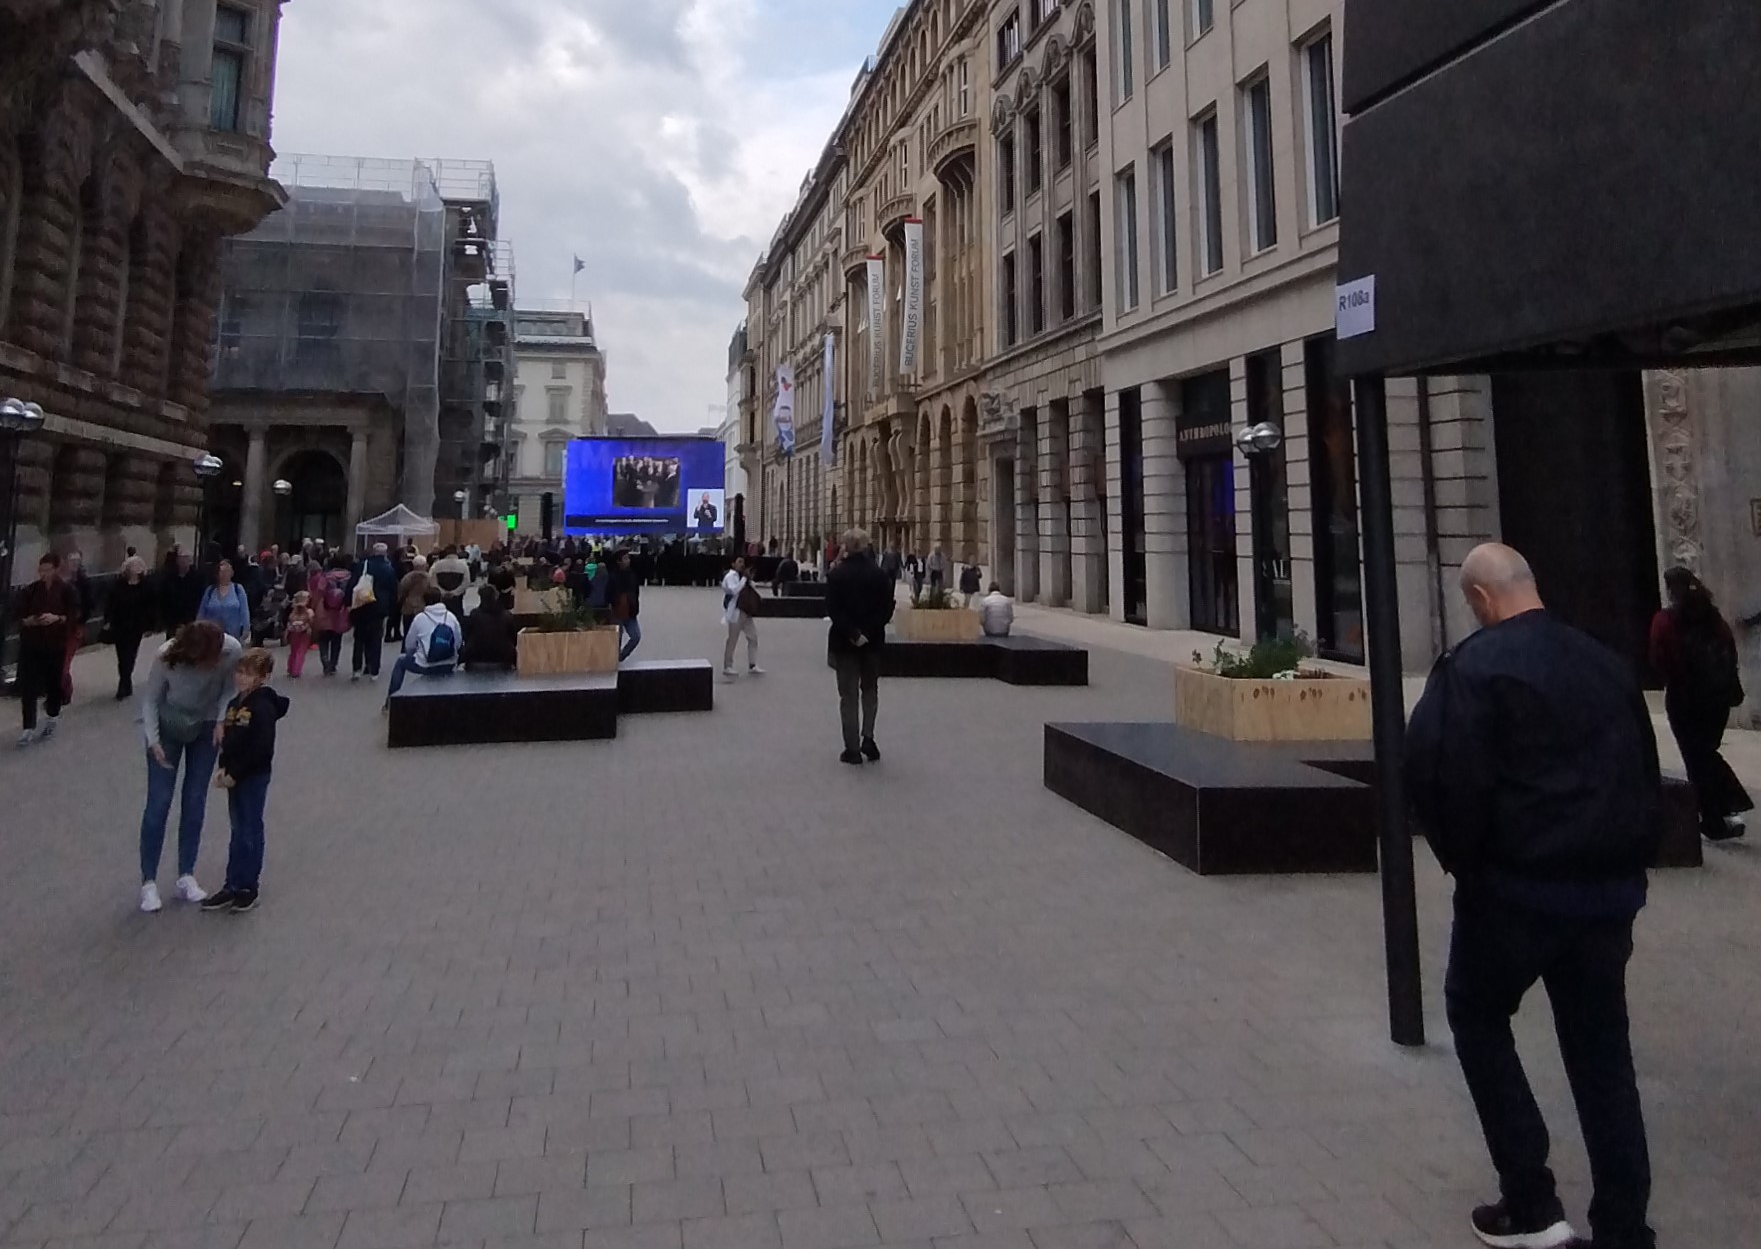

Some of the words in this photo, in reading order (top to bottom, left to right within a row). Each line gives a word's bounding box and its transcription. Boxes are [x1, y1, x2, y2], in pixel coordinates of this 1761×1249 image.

[911, 238, 920, 273] FORUM
[872, 273, 881, 305] FORUM
[909, 274, 920, 311] KUNST
